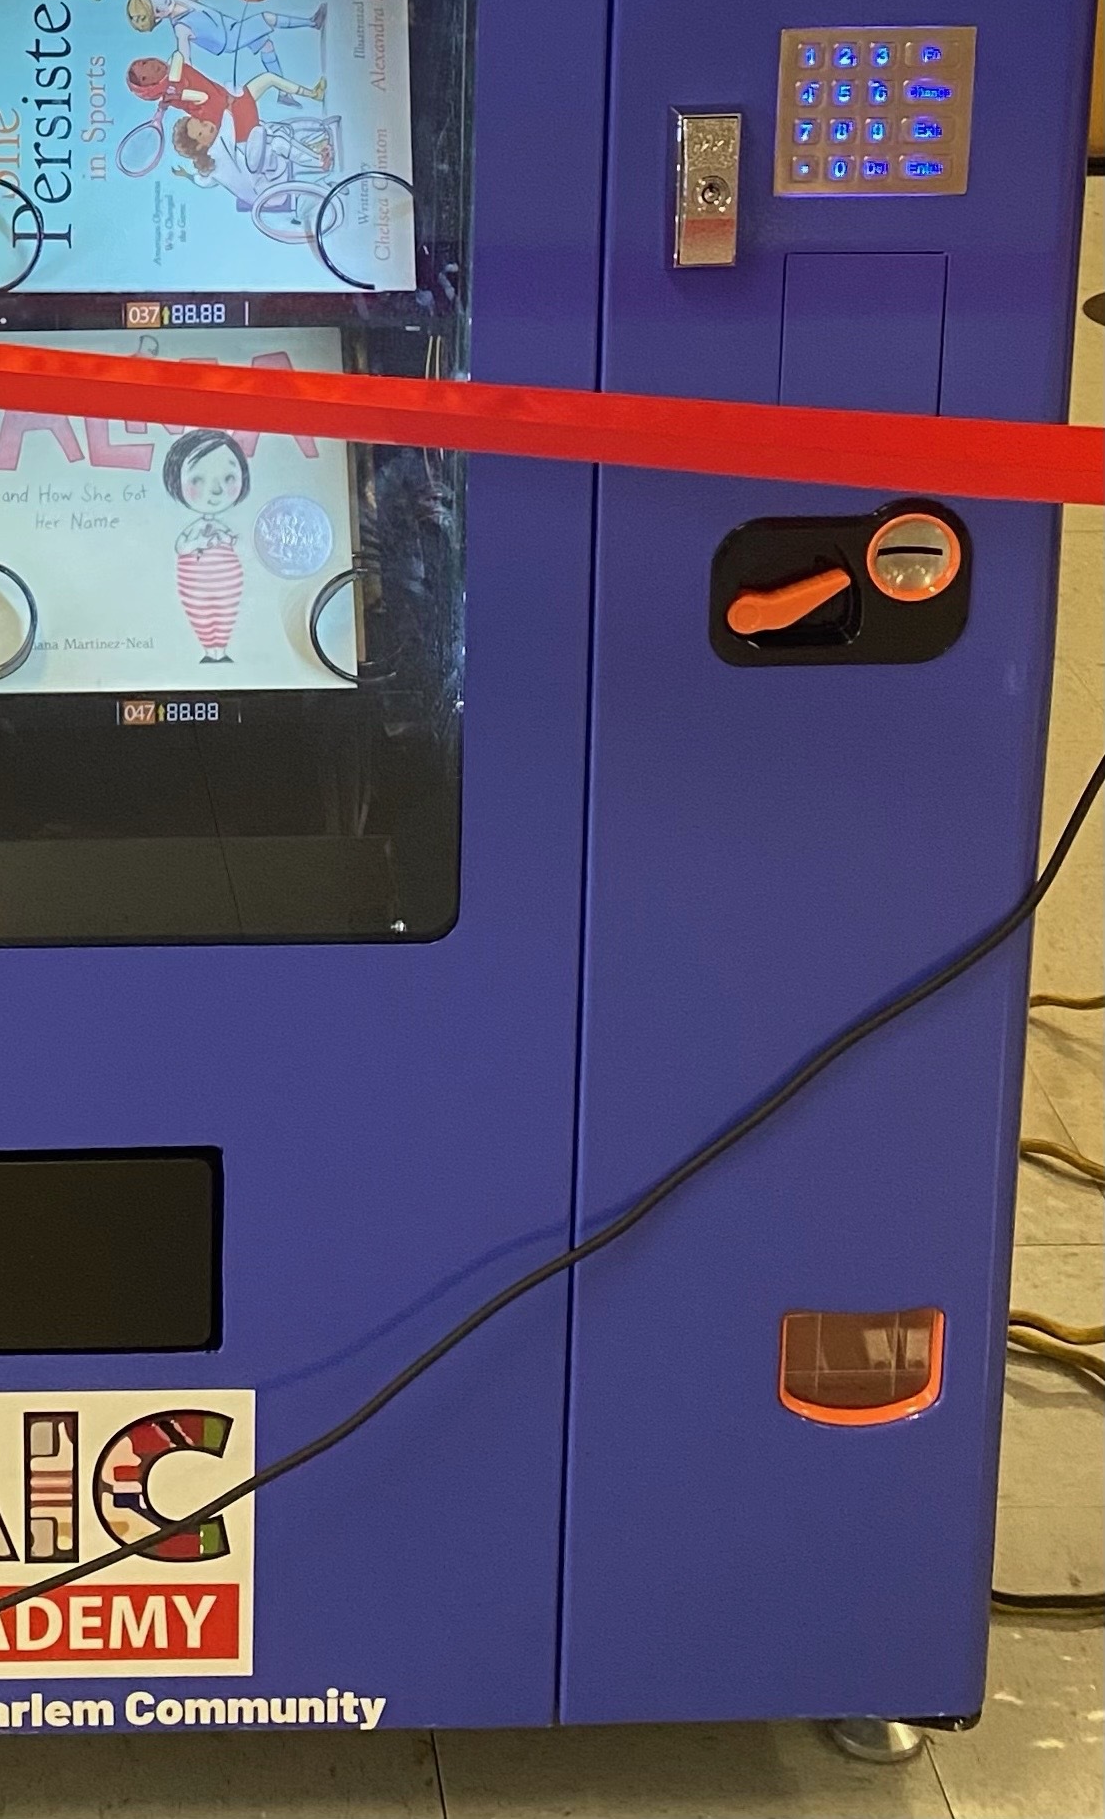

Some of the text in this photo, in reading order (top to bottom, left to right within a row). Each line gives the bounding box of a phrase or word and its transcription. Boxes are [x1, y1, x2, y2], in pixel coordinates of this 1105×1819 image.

[353, 3, 367, 60] Illustrated
[370, 4, 387, 92] Alexandra
[806, 48, 816, 66] 1
[839, 48, 852, 65] 2
[876, 47, 890, 66] 3
[802, 85, 814, 103] 4
[838, 85, 851, 102] 5
[875, 85, 888, 102] 6
[81, 55, 114, 182] in Sports
[800, 124, 813, 142] 7
[872, 124, 884, 141] 9
[371, 128, 390, 261] Chelsea Cinton
[128, 304, 226, 324] 037 88.88
[2, 483, 149, 503] and How She Got
[35, 512, 120, 530] Her Name
[124, 702, 219, 722] 047 88.88
[123, 1687, 387, 1731] Community
